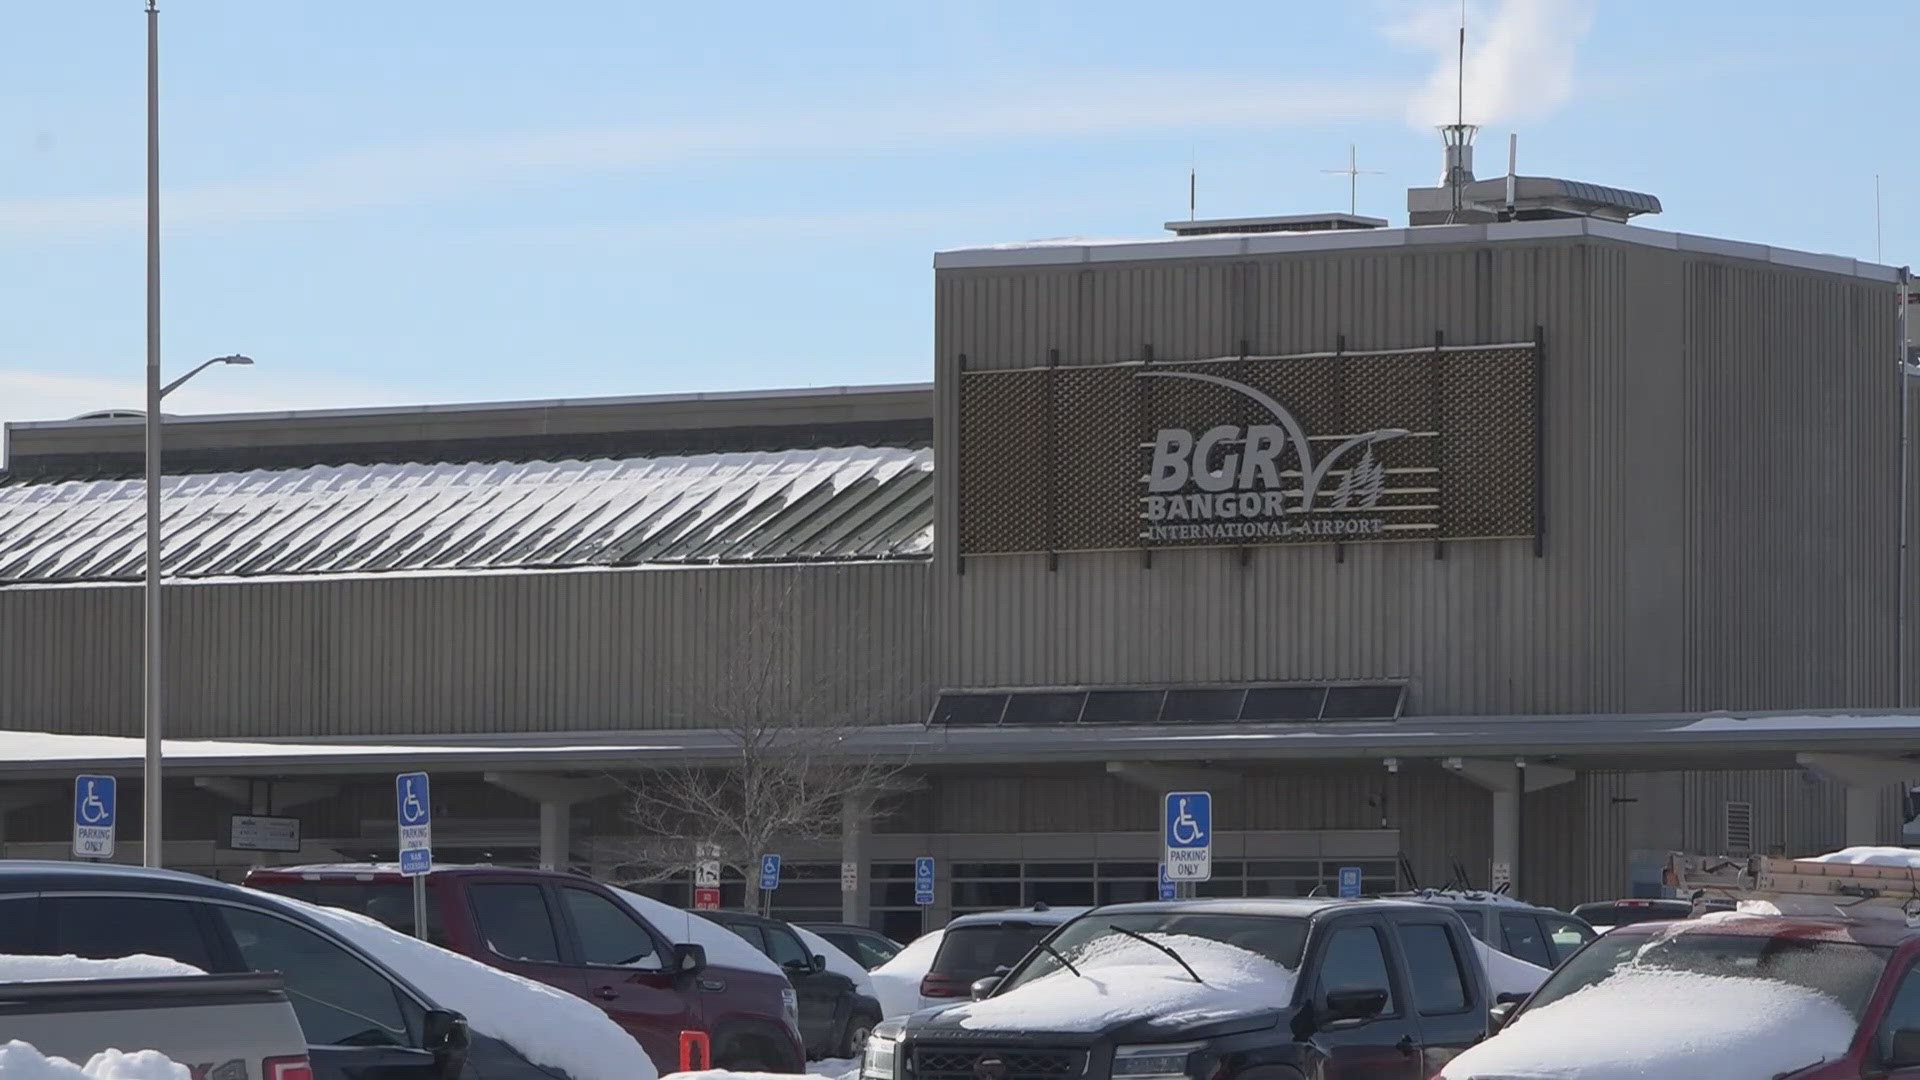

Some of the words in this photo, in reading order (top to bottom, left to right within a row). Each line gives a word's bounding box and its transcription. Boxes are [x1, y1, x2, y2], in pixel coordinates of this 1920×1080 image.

[1149, 424, 1285, 492] BGR
[1148, 491, 1284, 521] BANGOR
[1150, 521, 1292, 540] INTERNATIONAL
[1300, 518, 1383, 535] AIRPORT
[79, 828, 111, 840] PARKING
[402, 827, 428, 838] PARKING
[84, 840, 104, 851] ONLY
[1170, 850, 1207, 861] PARKING
[1177, 863, 1199, 876] ONLY
